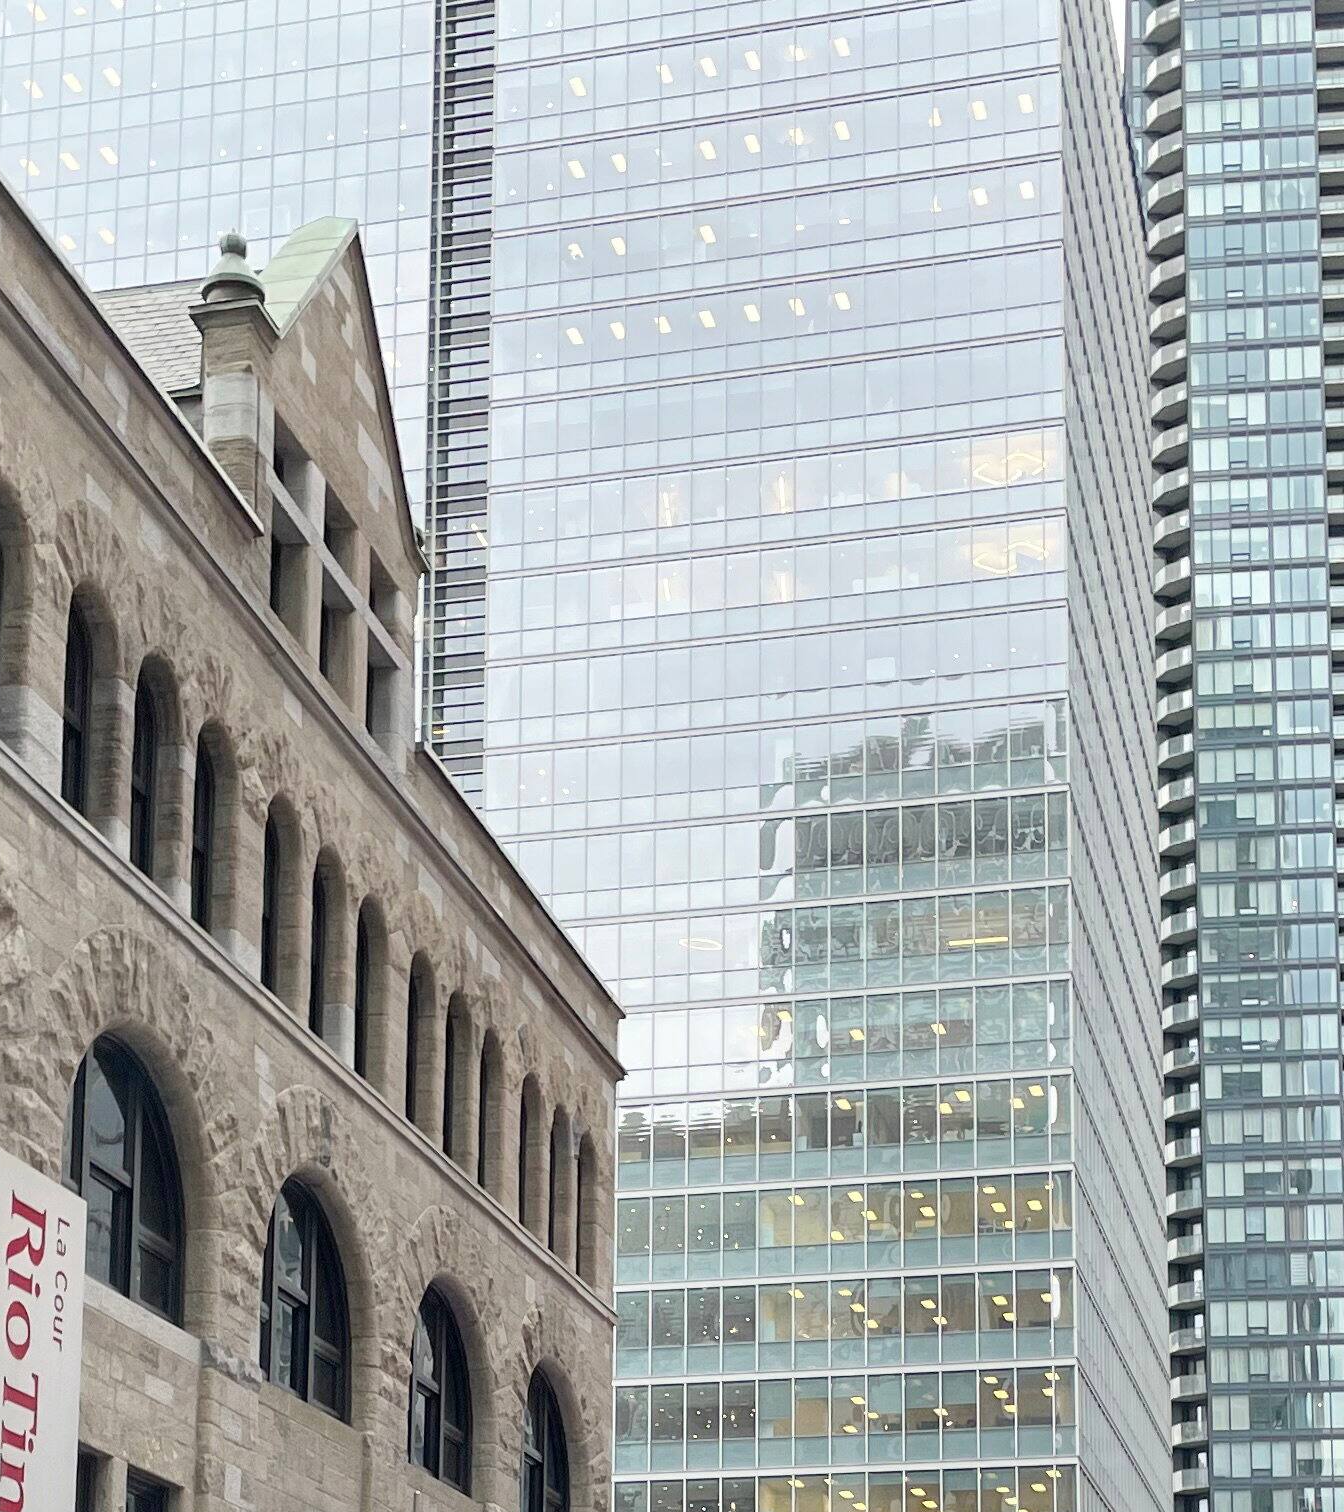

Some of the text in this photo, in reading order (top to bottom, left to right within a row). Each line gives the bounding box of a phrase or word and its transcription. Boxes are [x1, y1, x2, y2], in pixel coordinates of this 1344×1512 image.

[5, 1189, 47, 1361] Rio
[52, 1217, 70, 1352] La Cour
